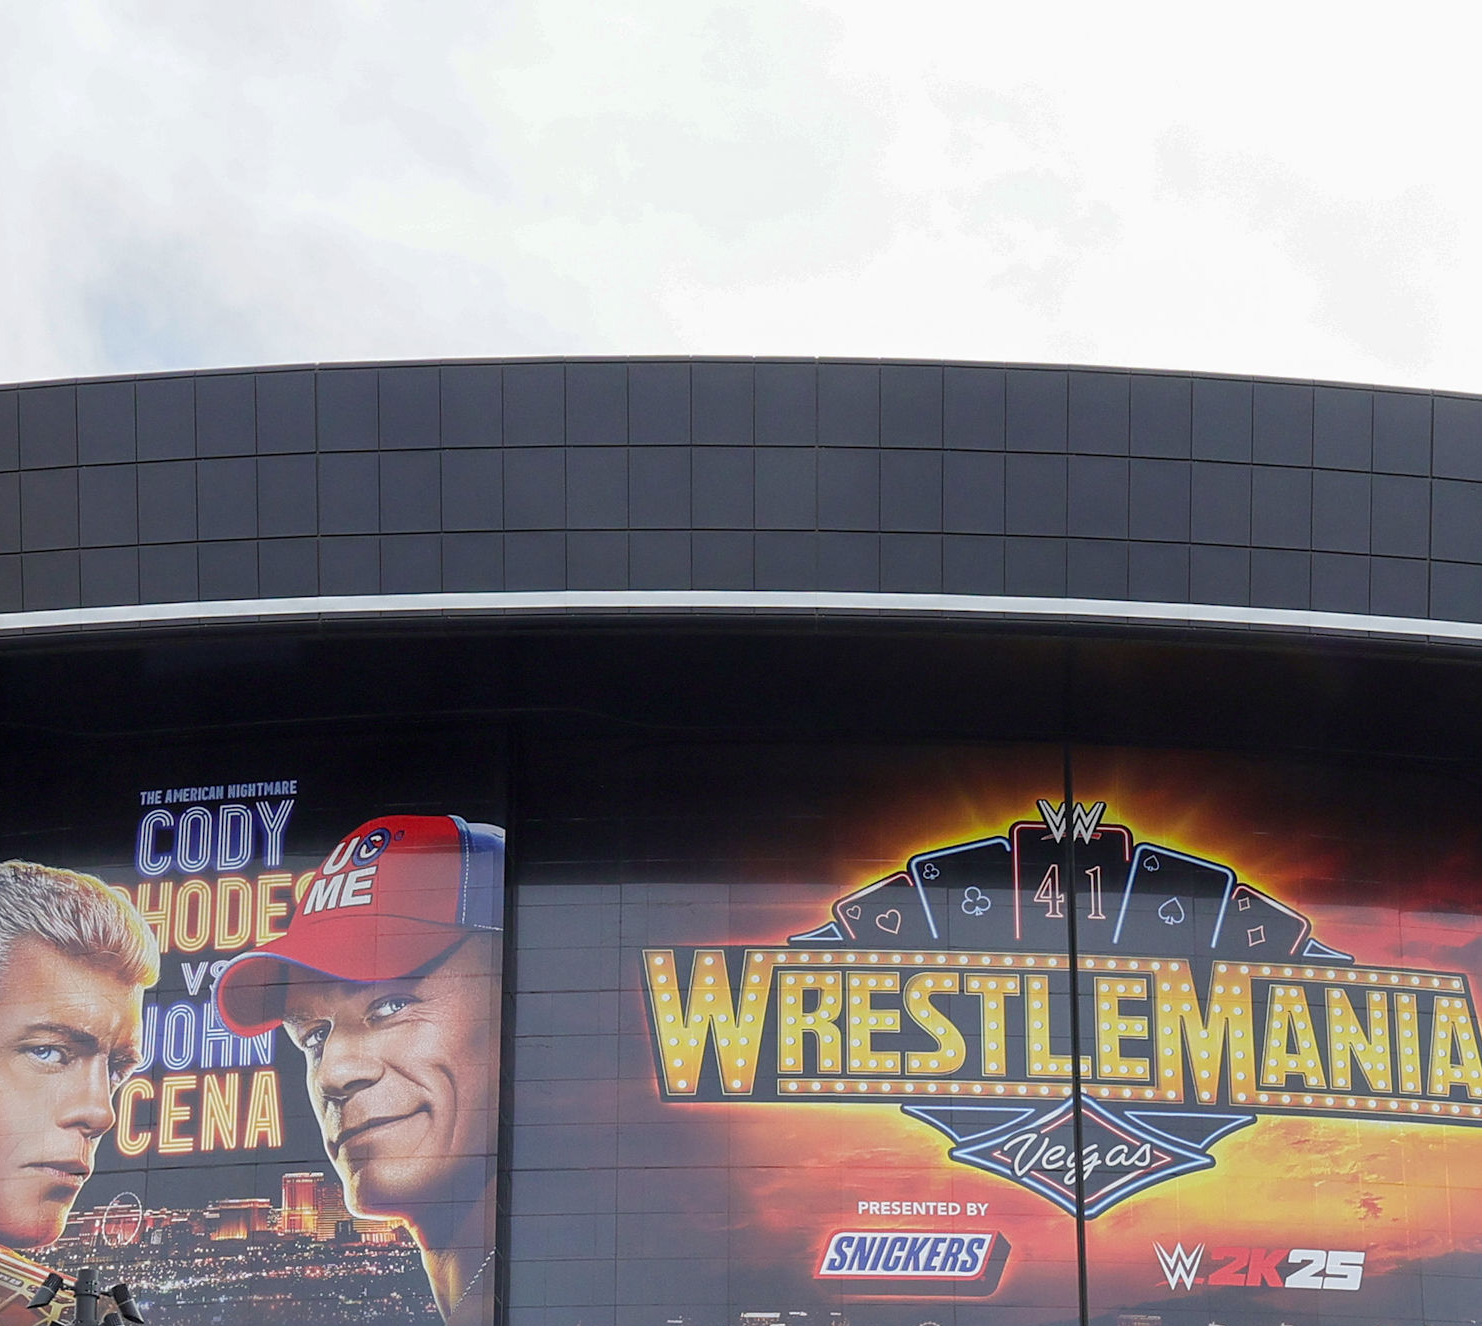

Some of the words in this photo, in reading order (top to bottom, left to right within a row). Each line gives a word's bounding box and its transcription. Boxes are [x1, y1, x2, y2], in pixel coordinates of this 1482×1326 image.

[140, 790, 162, 805] THE
[165, 785, 224, 803] AMERICAN
[228, 780, 298, 799] NIGHTMARE
[138, 800, 294, 876] CODY
[303, 866, 378, 915] ME
[117, 1071, 282, 1155] CENA
[1003, 1133, 1151, 1186] Vegas
[858, 1201, 961, 1216] PRESENTED
[967, 1202, 989, 1217] BY
[826, 1236, 986, 1273] SNICKERS
[1208, 1248, 1366, 1291] 2K25
